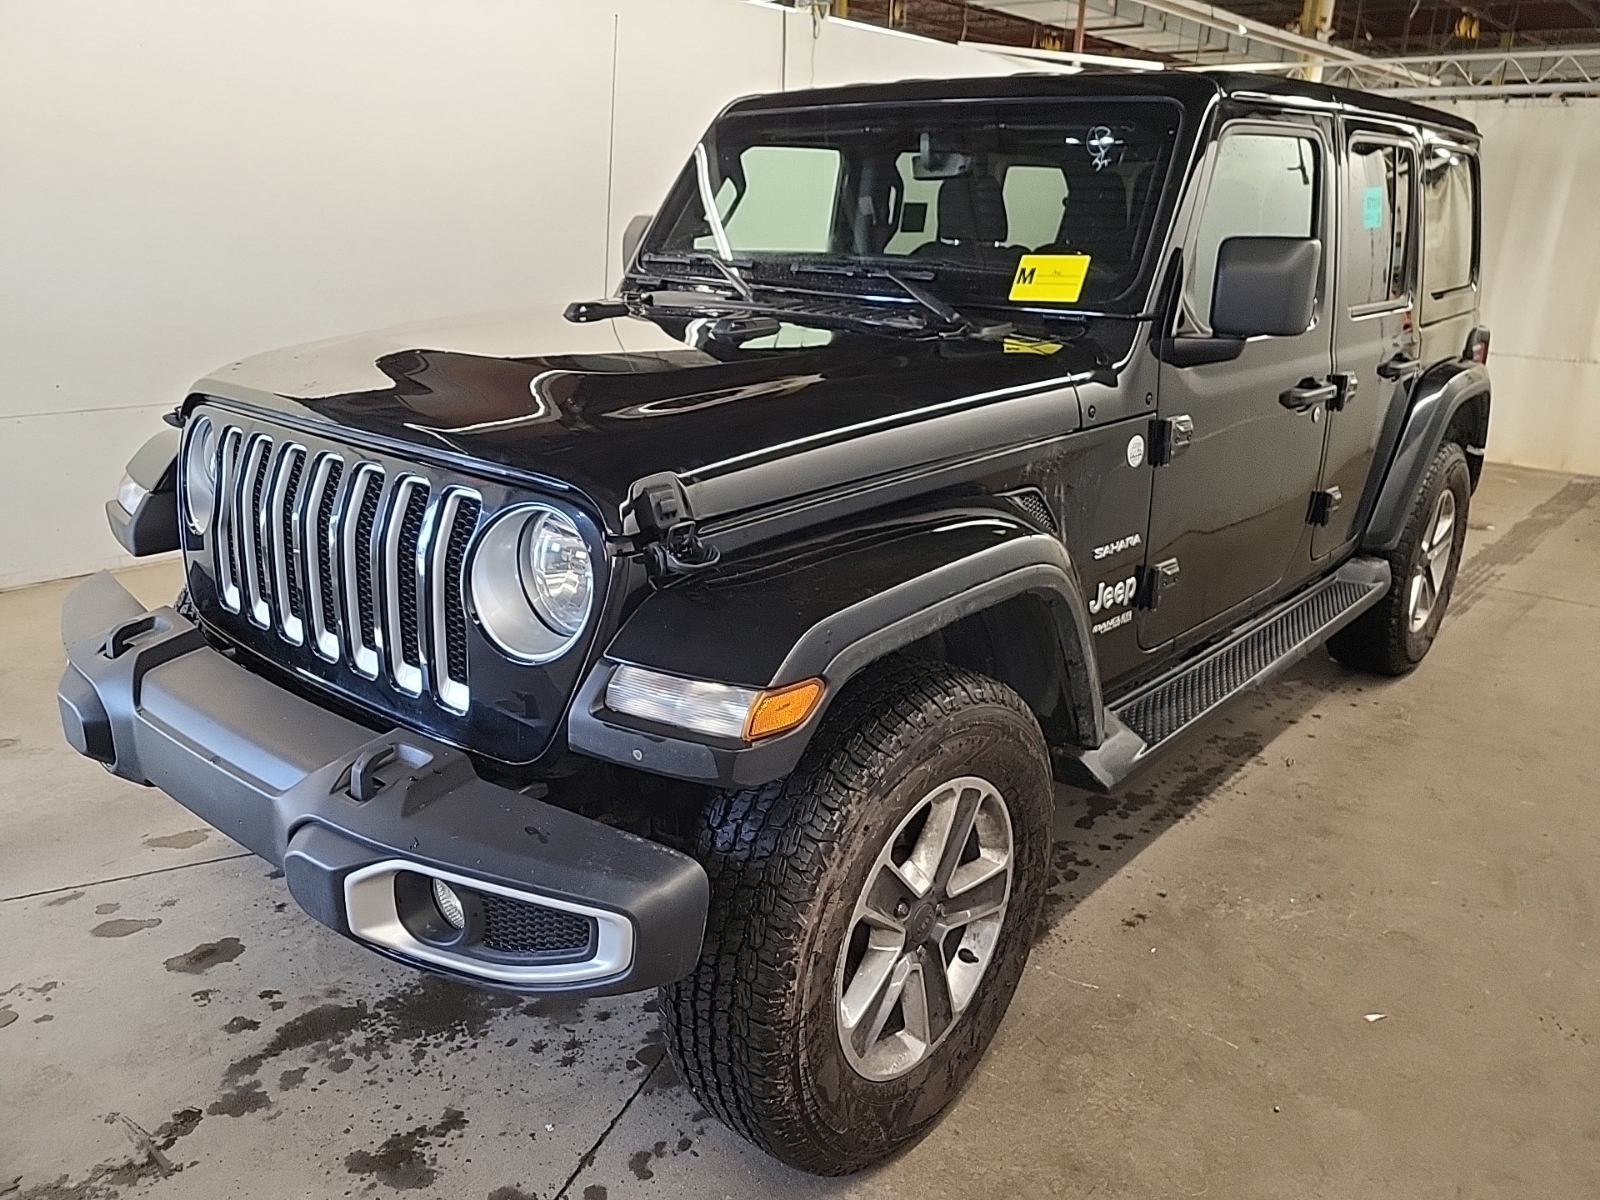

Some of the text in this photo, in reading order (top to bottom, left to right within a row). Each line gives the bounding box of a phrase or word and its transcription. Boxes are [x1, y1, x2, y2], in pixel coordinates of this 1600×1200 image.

[1016, 267, 1036, 285] M
[1093, 534, 1141, 559] SAHARA
[1089, 576, 1136, 614] Jeep
